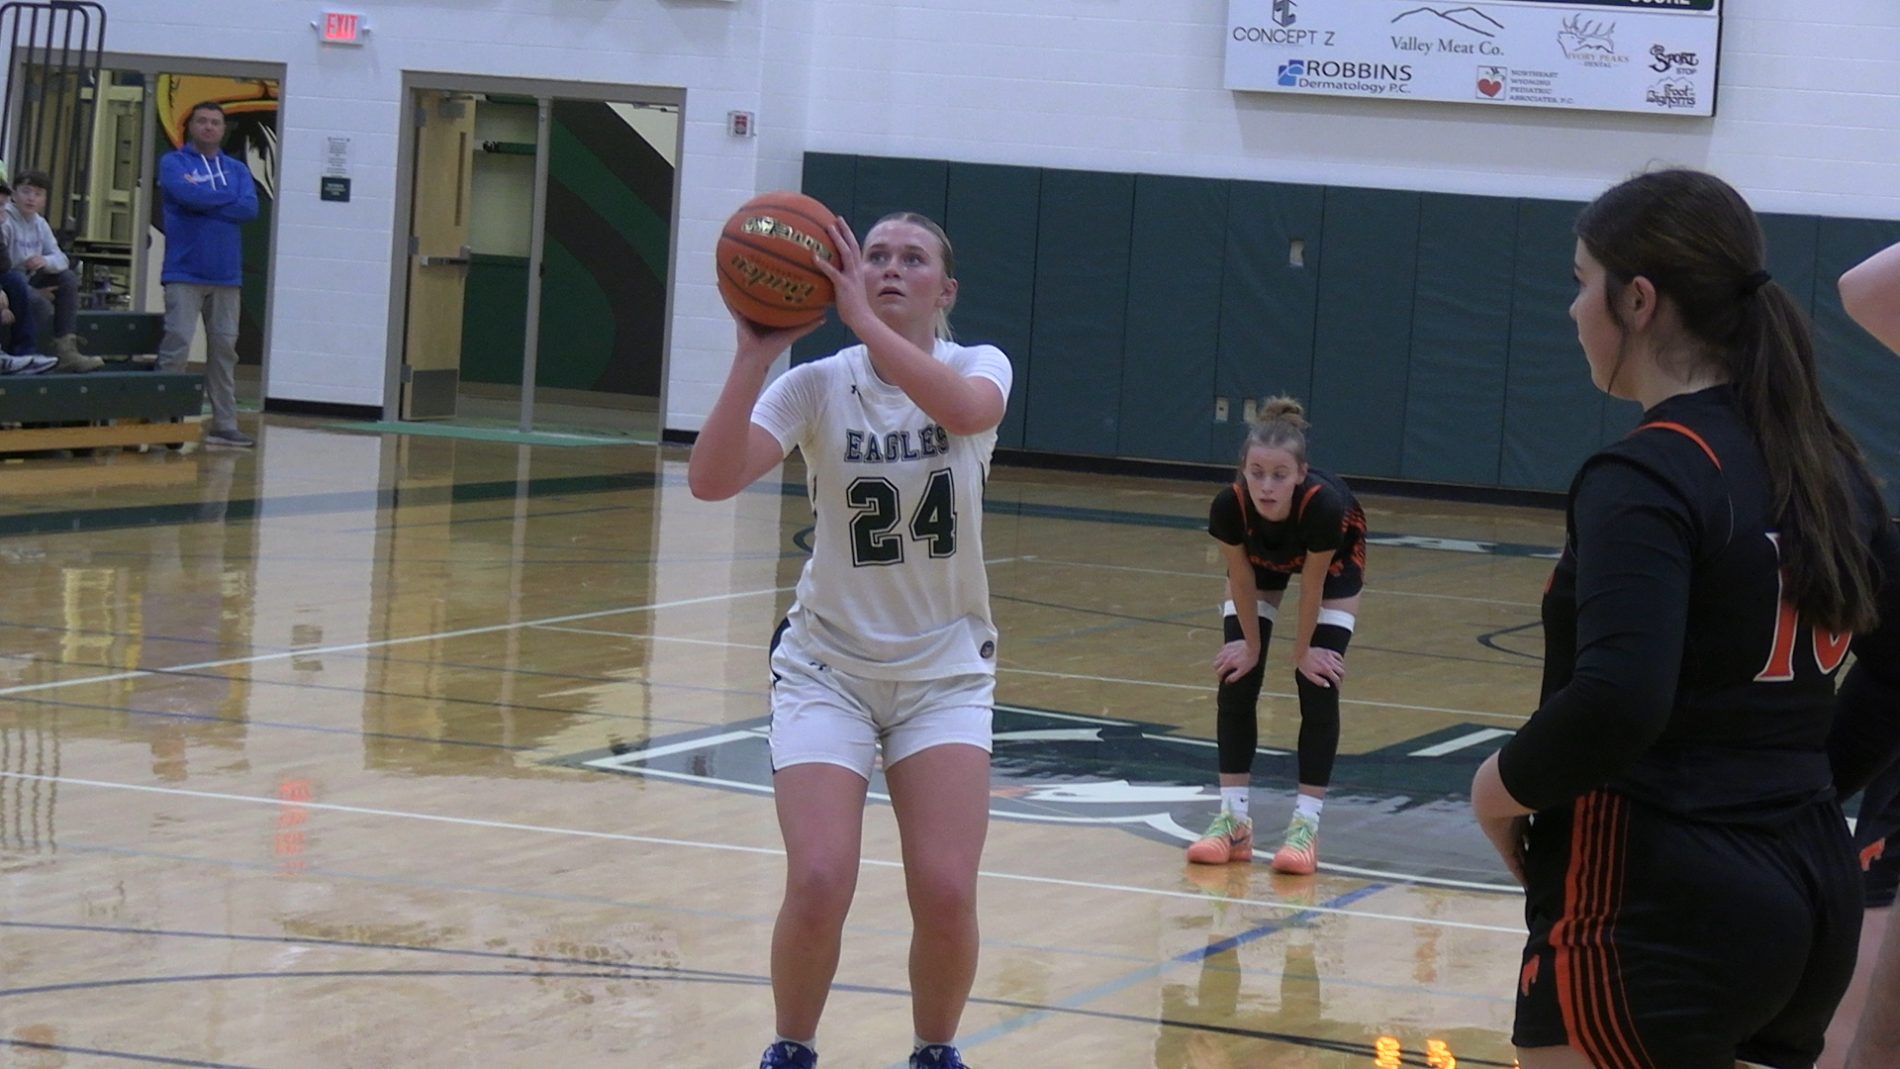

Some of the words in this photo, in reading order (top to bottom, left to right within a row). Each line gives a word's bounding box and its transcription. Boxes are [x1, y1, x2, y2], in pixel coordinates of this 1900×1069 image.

[326, 13, 359, 40] EXIT
[1233, 26, 1318, 45] CONCEPT
[1324, 31, 1336, 46] Z
[1391, 35, 1433, 56] Valley
[1438, 38, 1474, 54] Meat
[1479, 40, 1504, 56] Co.
[1306, 60, 1412, 81] ROBBINS
[1299, 78, 1385, 94] Dermatology
[1389, 86, 1411, 94] P.C.
[844, 424, 950, 463] EAGLES
[846, 467, 958, 567] 24
